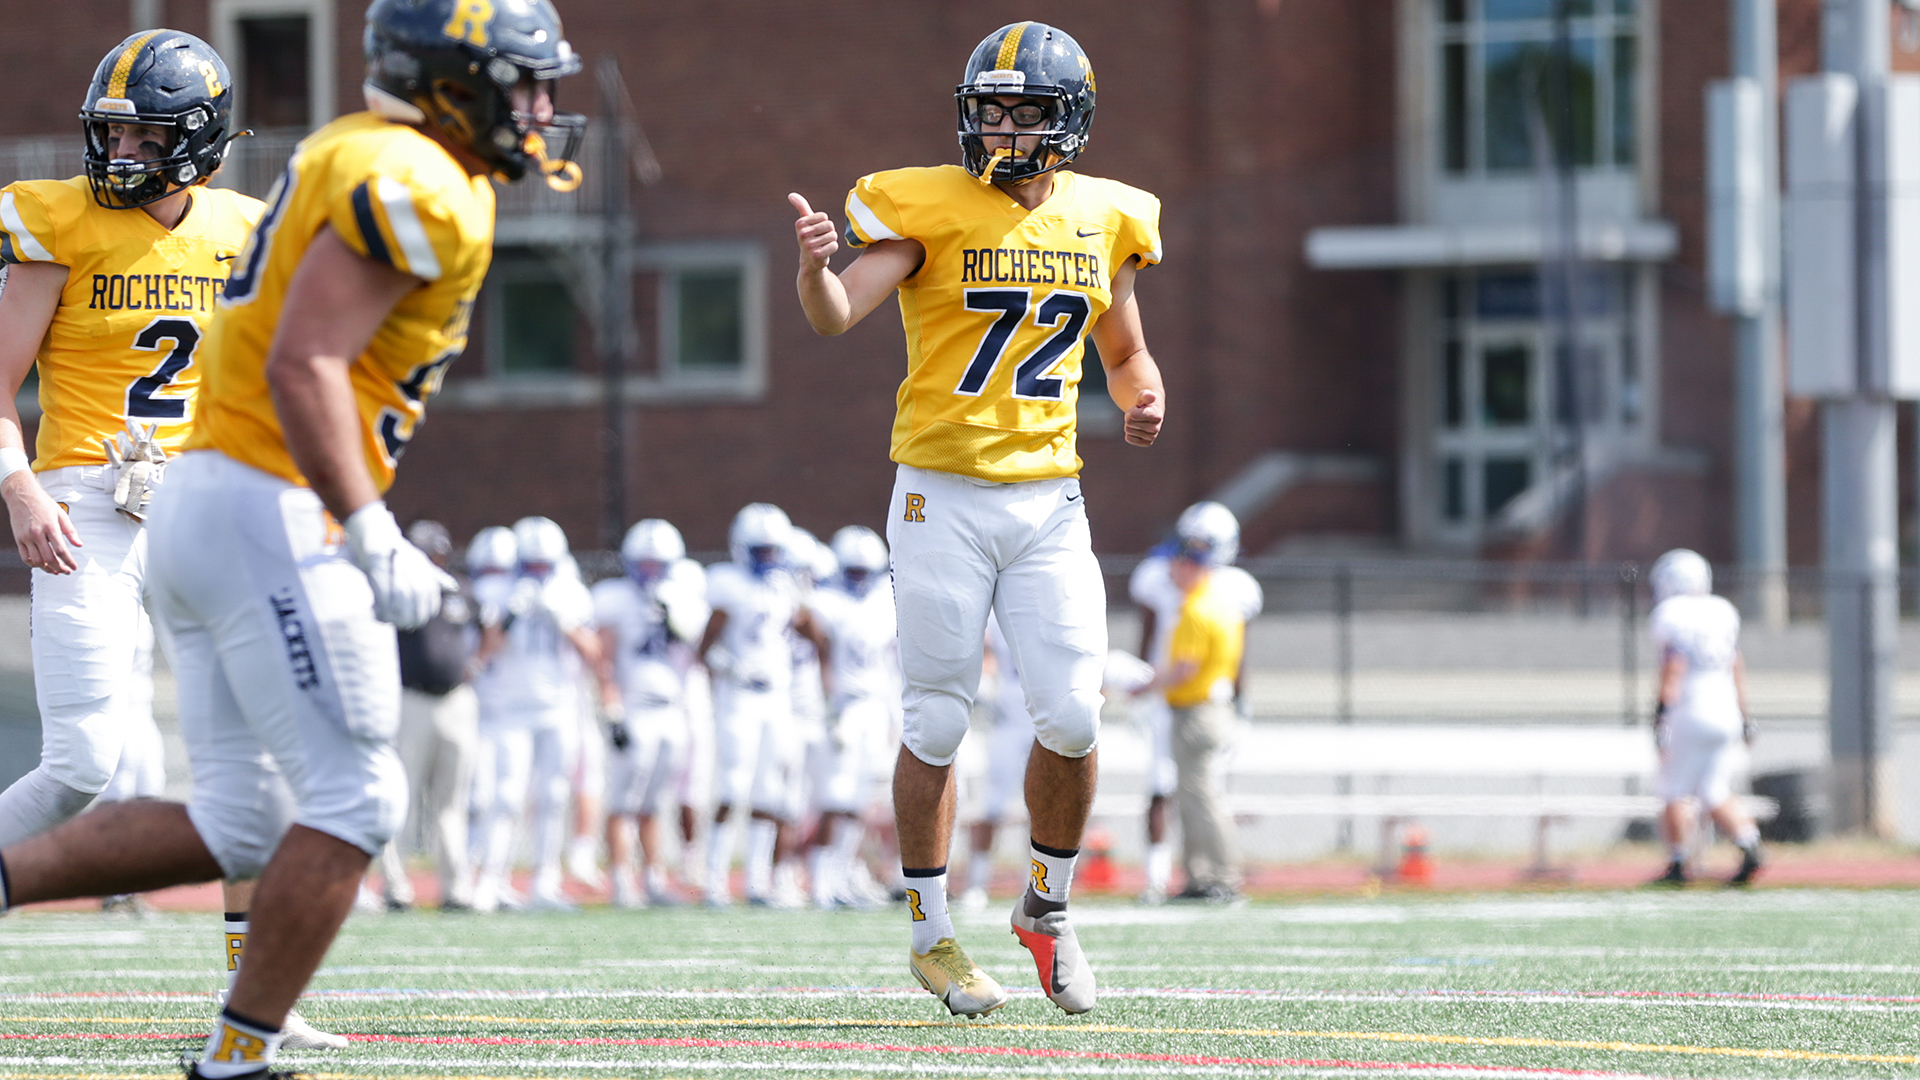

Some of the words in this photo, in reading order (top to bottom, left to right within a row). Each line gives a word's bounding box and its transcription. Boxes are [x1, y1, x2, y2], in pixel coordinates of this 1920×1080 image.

[443, 0, 494, 48] R
[198, 60, 223, 98] 2
[961, 248, 1101, 289] ROCHESTER
[953, 287, 1092, 402] 72
[124, 315, 204, 422] 2
[904, 492, 925, 522] R
[1031, 858, 1050, 893] R
[905, 888, 926, 921] R
[212, 1023, 266, 1062] R
